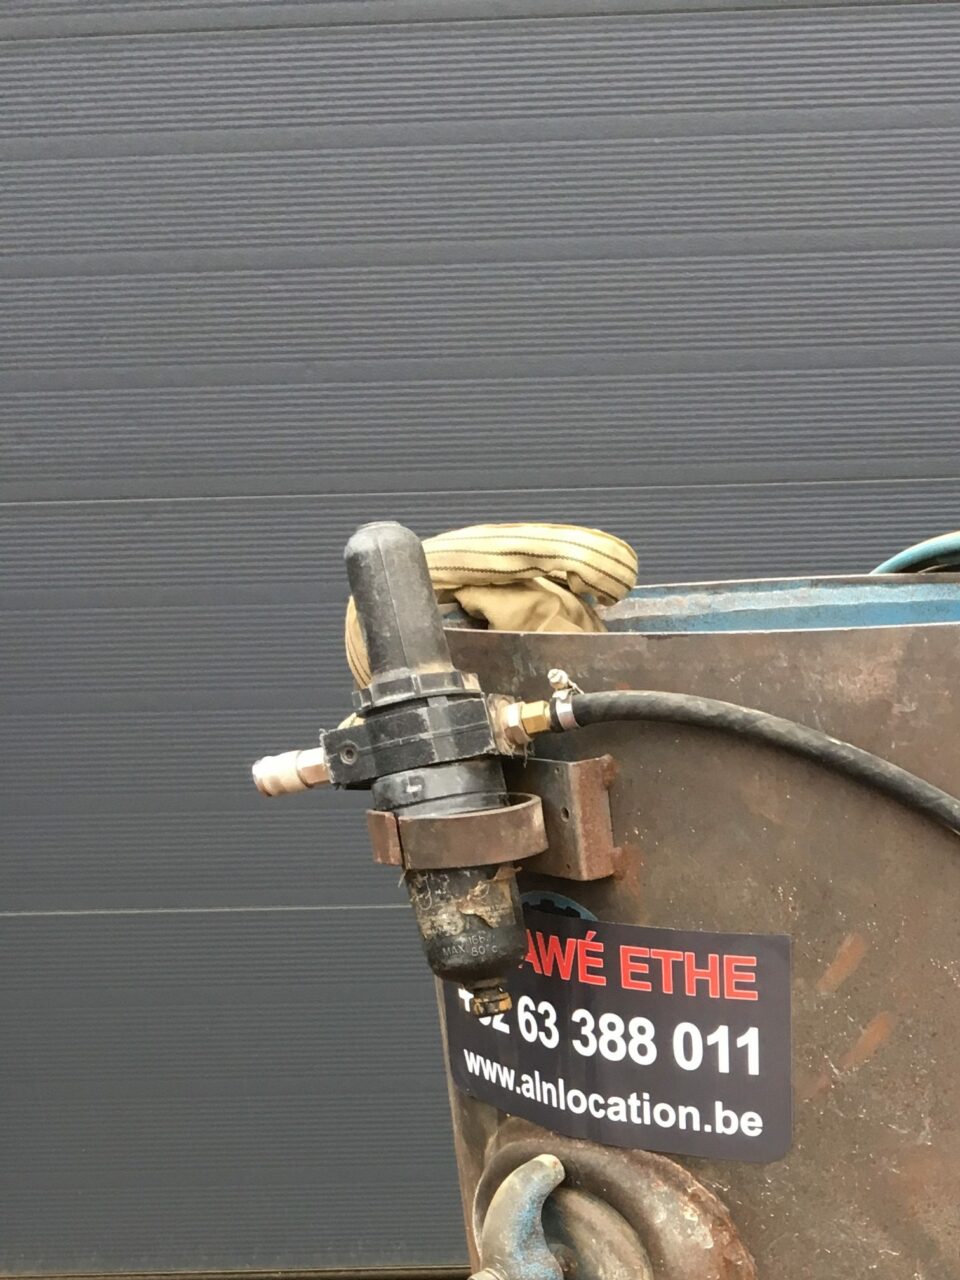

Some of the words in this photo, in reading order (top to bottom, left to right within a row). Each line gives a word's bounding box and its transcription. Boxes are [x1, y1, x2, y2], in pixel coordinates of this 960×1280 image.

[619, 944, 759, 1001] ETHE
[517, 994, 560, 1049] 63
[570, 1008, 658, 1066] 388
[672, 1021, 760, 1076] 011
[463, 1048, 764, 1137] www.alnlocation.be
